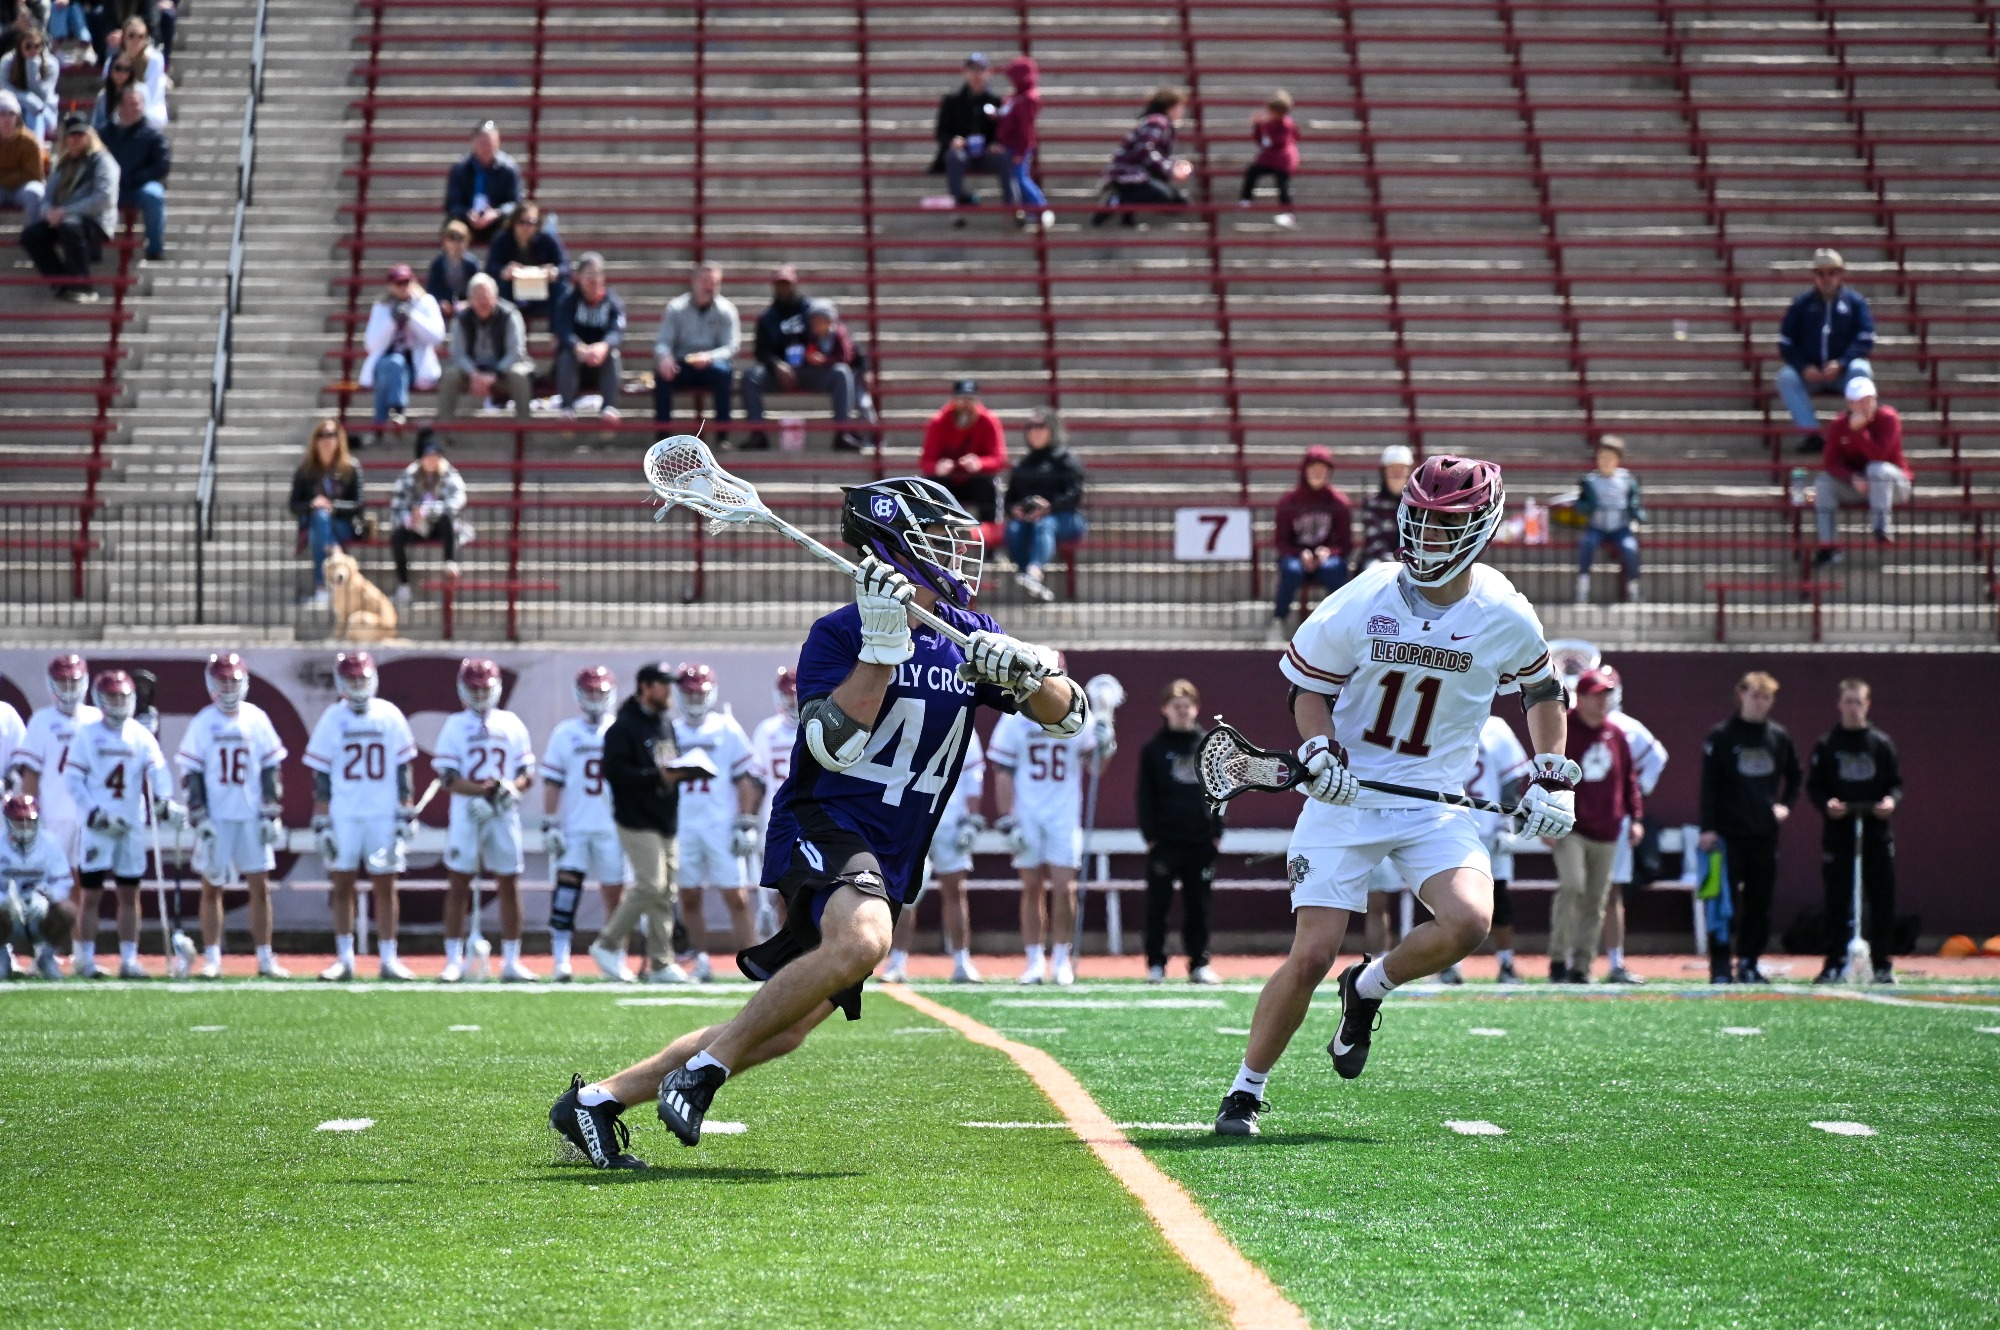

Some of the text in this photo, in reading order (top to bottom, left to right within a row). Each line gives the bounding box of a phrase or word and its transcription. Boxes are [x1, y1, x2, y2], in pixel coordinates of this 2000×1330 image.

[1198, 515, 1228, 552] 7
[1422, 621, 1431, 631] L
[1371, 640, 1473, 672] LEOPARDS
[1361, 669, 1443, 757] 11
[343, 743, 384, 780] 20
[840, 697, 967, 814] 44
[1029, 744, 1067, 781] 56
[105, 762, 125, 798] 4
[1466, 761, 1484, 797] 2
